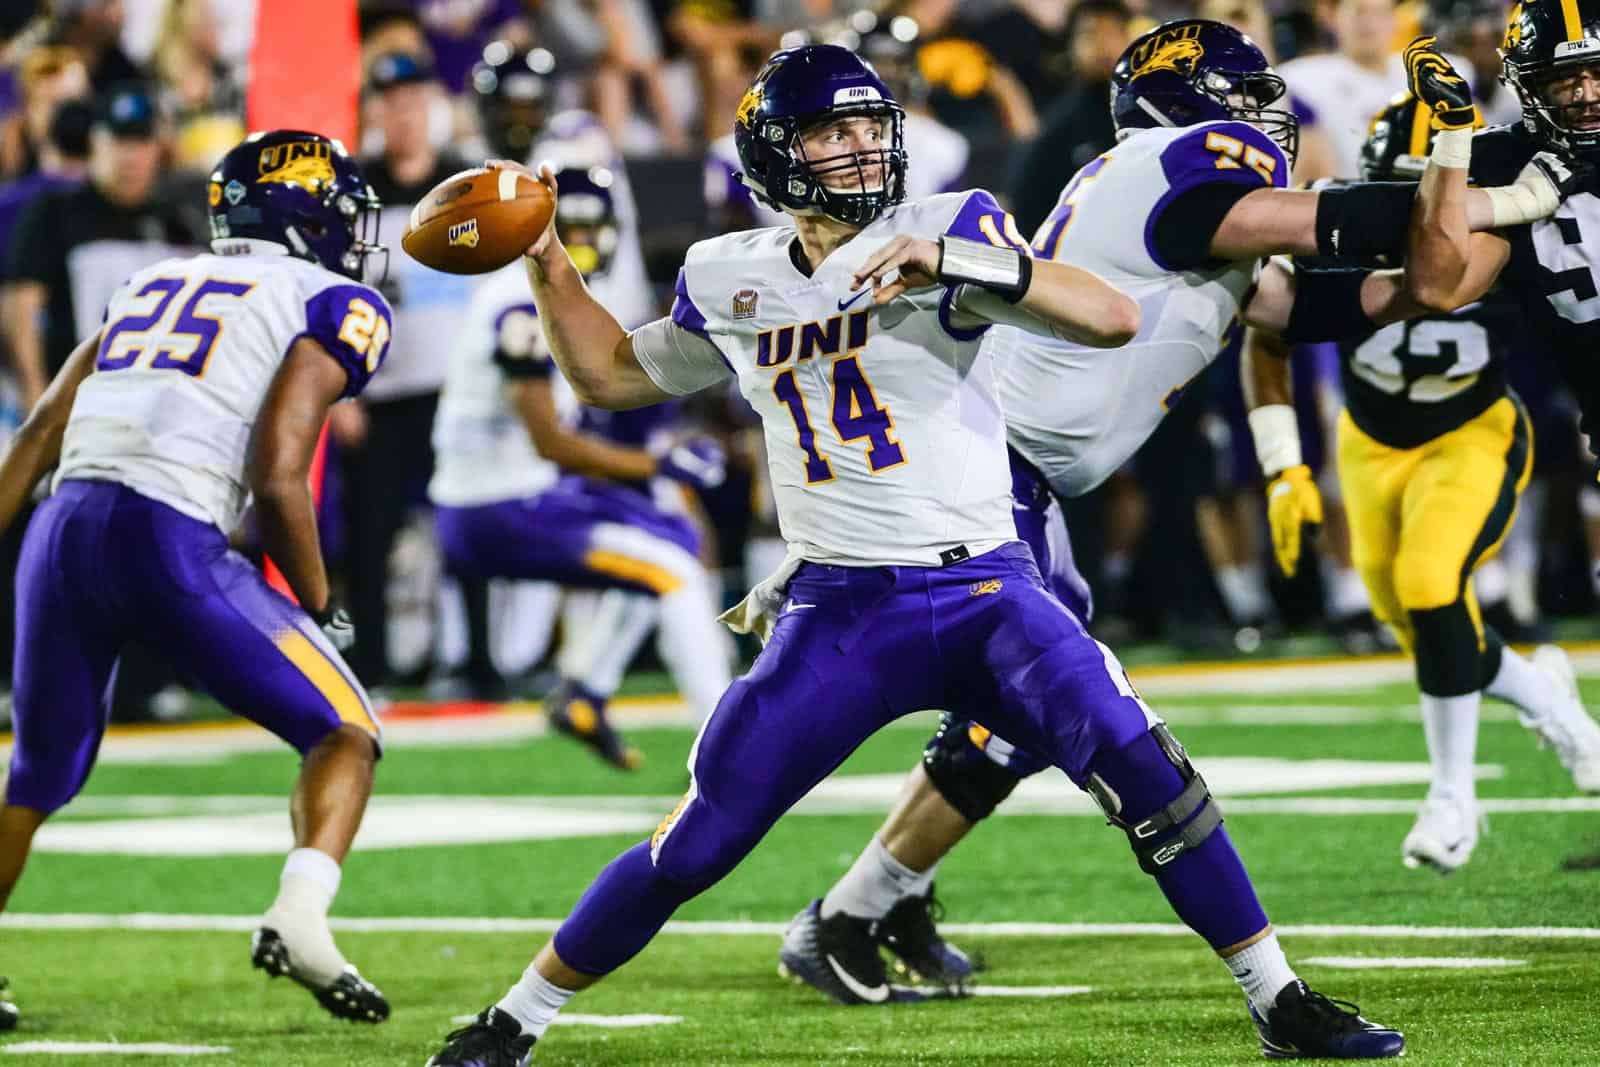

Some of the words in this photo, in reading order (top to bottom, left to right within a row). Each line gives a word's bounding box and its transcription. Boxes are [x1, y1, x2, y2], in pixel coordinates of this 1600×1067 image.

[1130, 25, 1201, 71] UNI
[849, 88, 868, 97] UNI
[257, 142, 331, 176] UNI
[1205, 131, 1278, 185] 75
[449, 218, 477, 241] UNI
[97, 275, 258, 379] 25
[756, 310, 869, 368] UNI
[773, 353, 908, 487] 14
[950, 551, 960, 560] L
